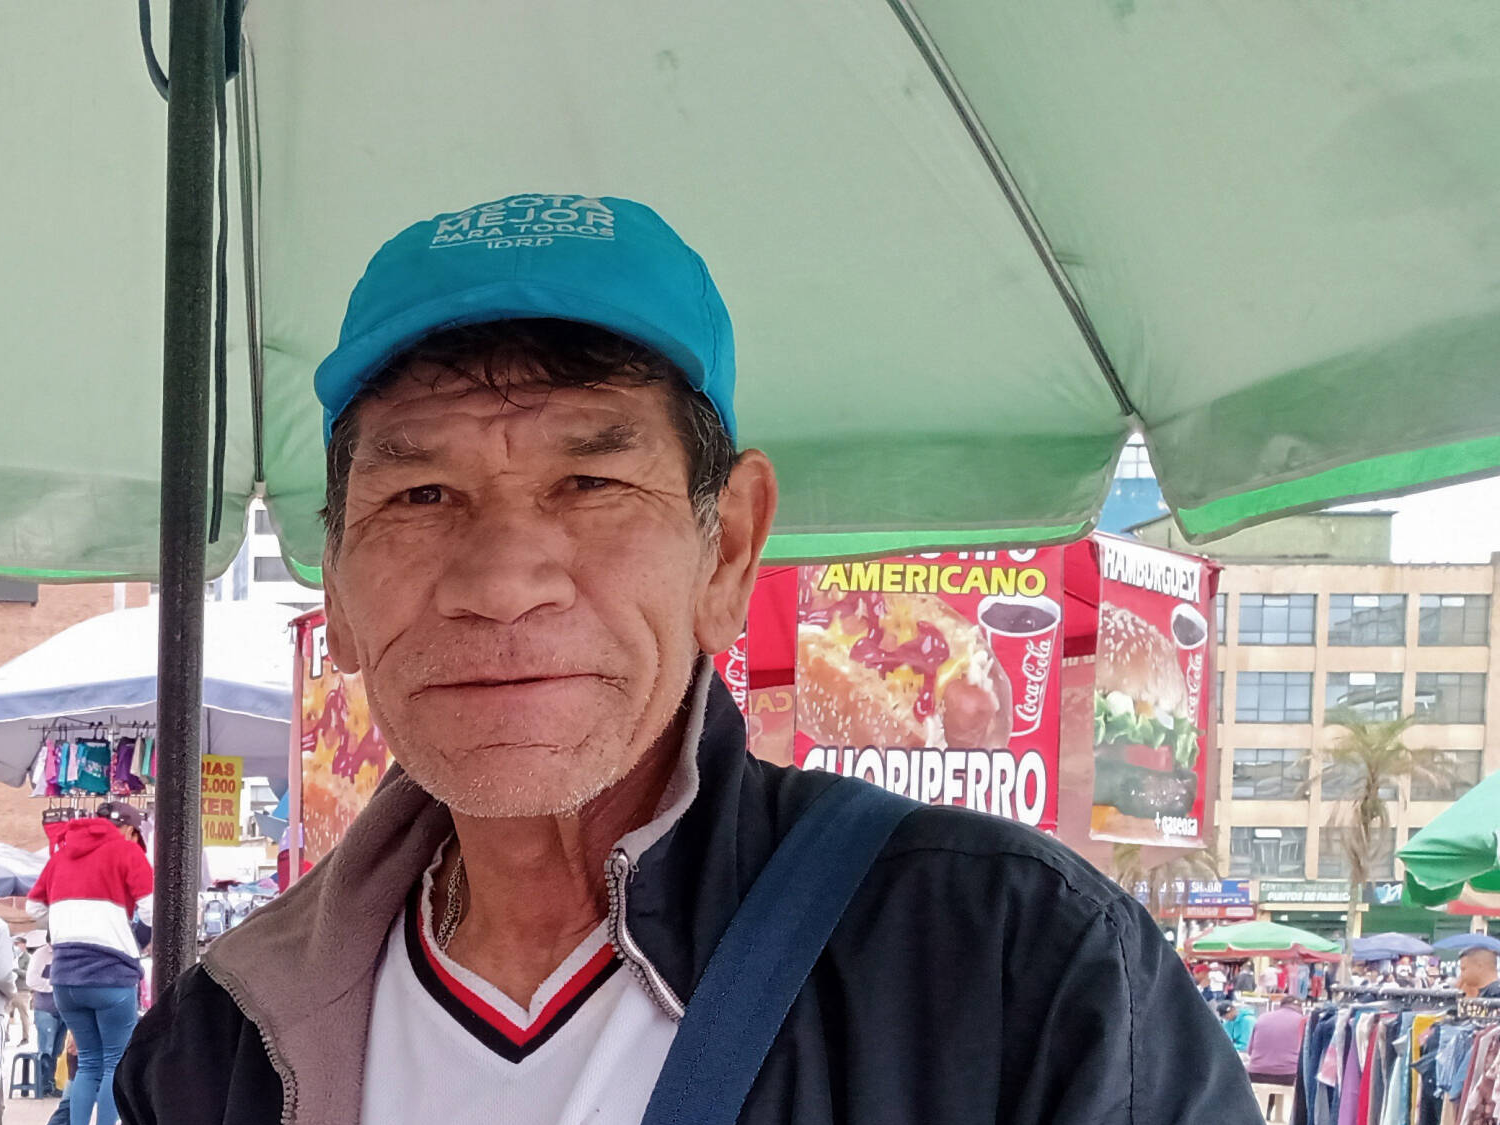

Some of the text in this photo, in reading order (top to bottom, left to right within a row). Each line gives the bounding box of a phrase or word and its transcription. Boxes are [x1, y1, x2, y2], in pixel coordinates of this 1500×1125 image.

[432, 223, 615, 245] PARA TODOS
[436, 207, 615, 236] MEJOR
[487, 237, 555, 249] IDRD
[818, 562, 1048, 597] AMERICANO
[1103, 547, 1200, 603] HAMBURGUESA
[1015, 638, 1052, 723] Coca-Cola
